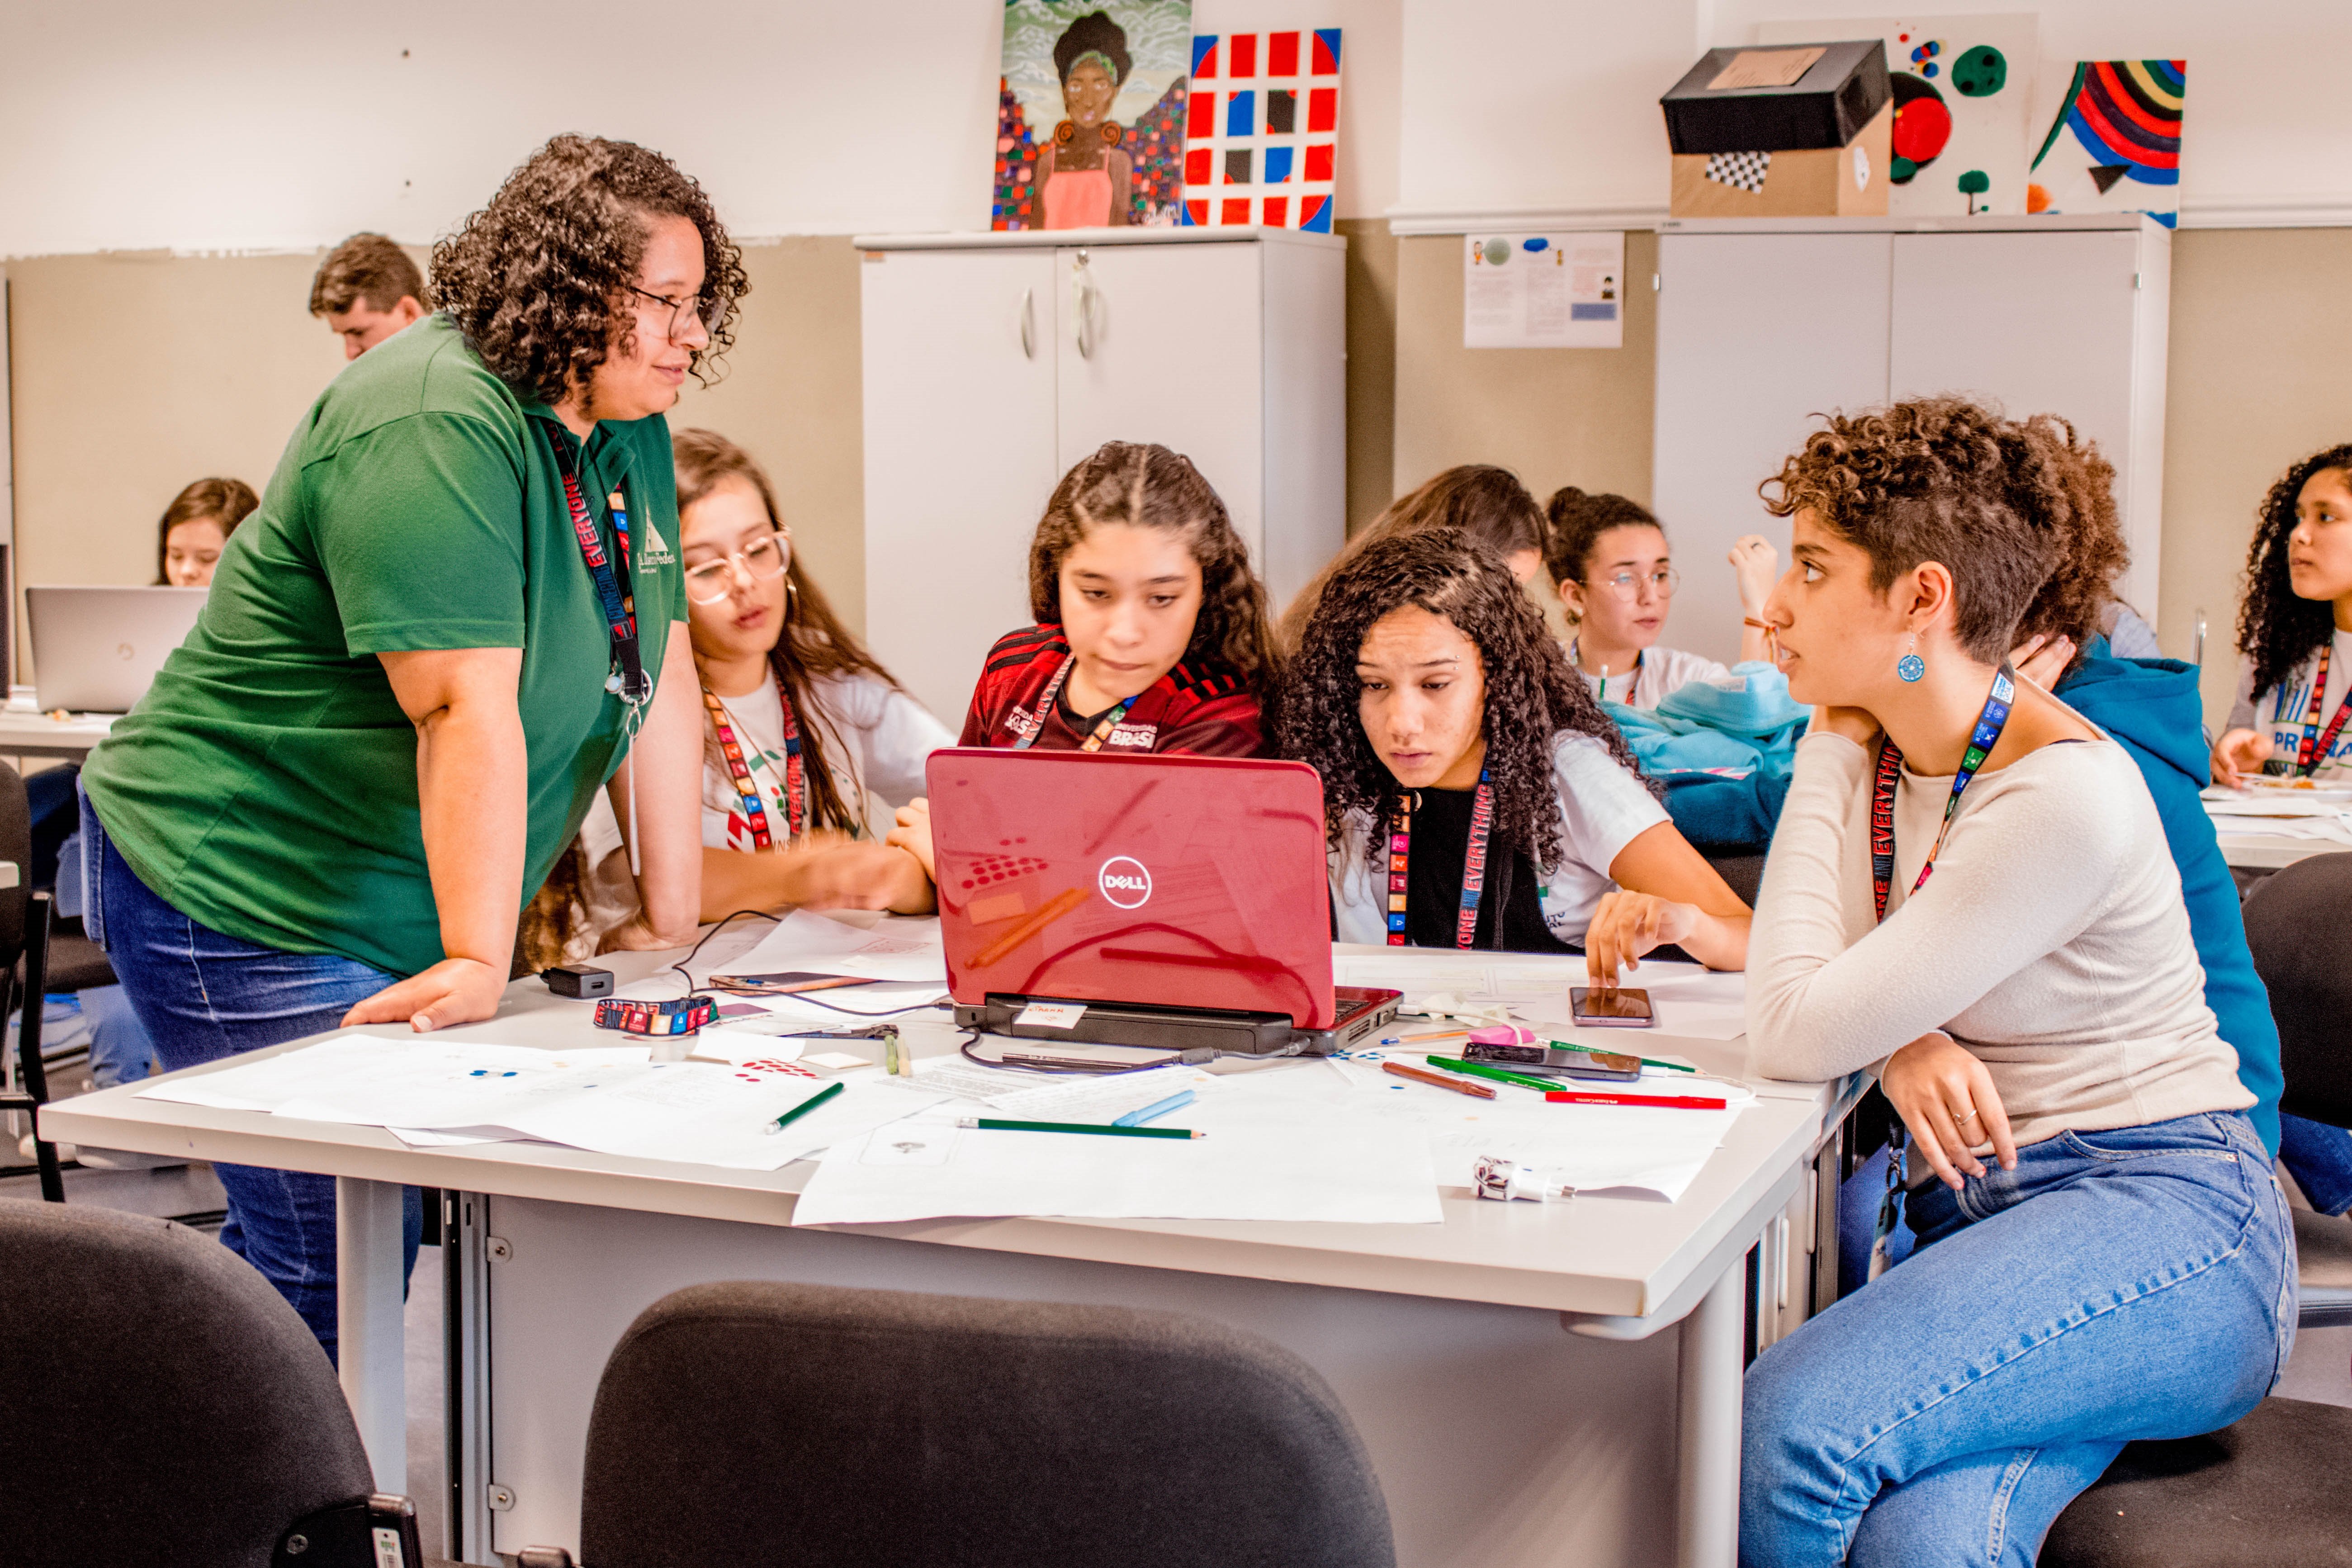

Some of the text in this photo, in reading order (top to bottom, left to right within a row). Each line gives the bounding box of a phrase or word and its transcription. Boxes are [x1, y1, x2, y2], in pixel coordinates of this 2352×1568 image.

[561, 472, 608, 567] EVERYONE
[1464, 784, 1493, 891] EVERYTHING
[1874, 738, 1900, 856] EVERYTHIN
[1105, 875, 1146, 890] DELL
[1462, 891, 1480, 909] AND
